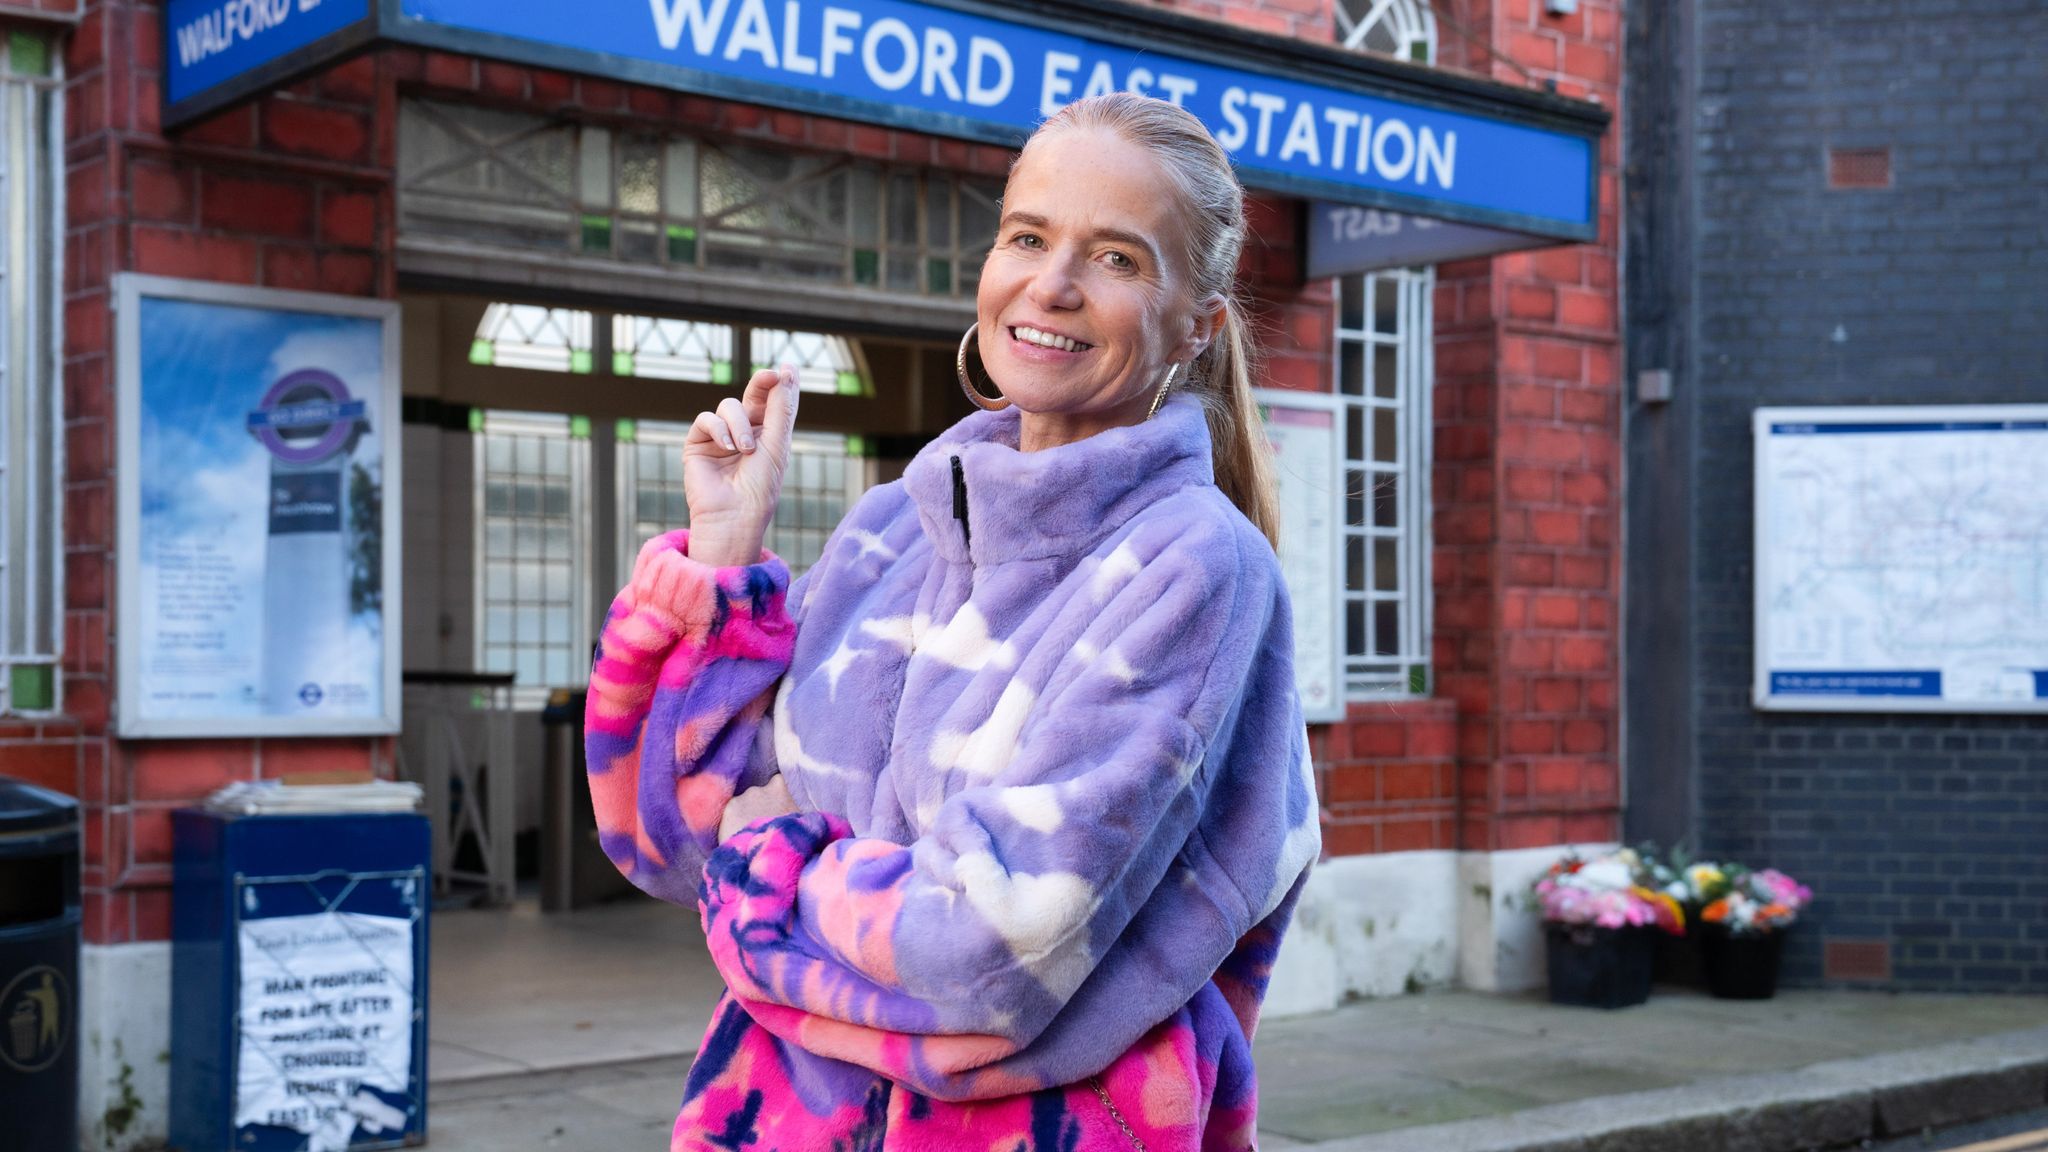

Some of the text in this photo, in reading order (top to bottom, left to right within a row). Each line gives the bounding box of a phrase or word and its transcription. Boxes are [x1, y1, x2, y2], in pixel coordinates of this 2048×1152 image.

[177, 0, 290, 68] WALFORD
[650, 0, 1014, 107] WALFORD
[1214, 84, 1457, 190] STATION
[264, 977, 304, 996] MAN
[340, 996, 392, 1015] AFTER
